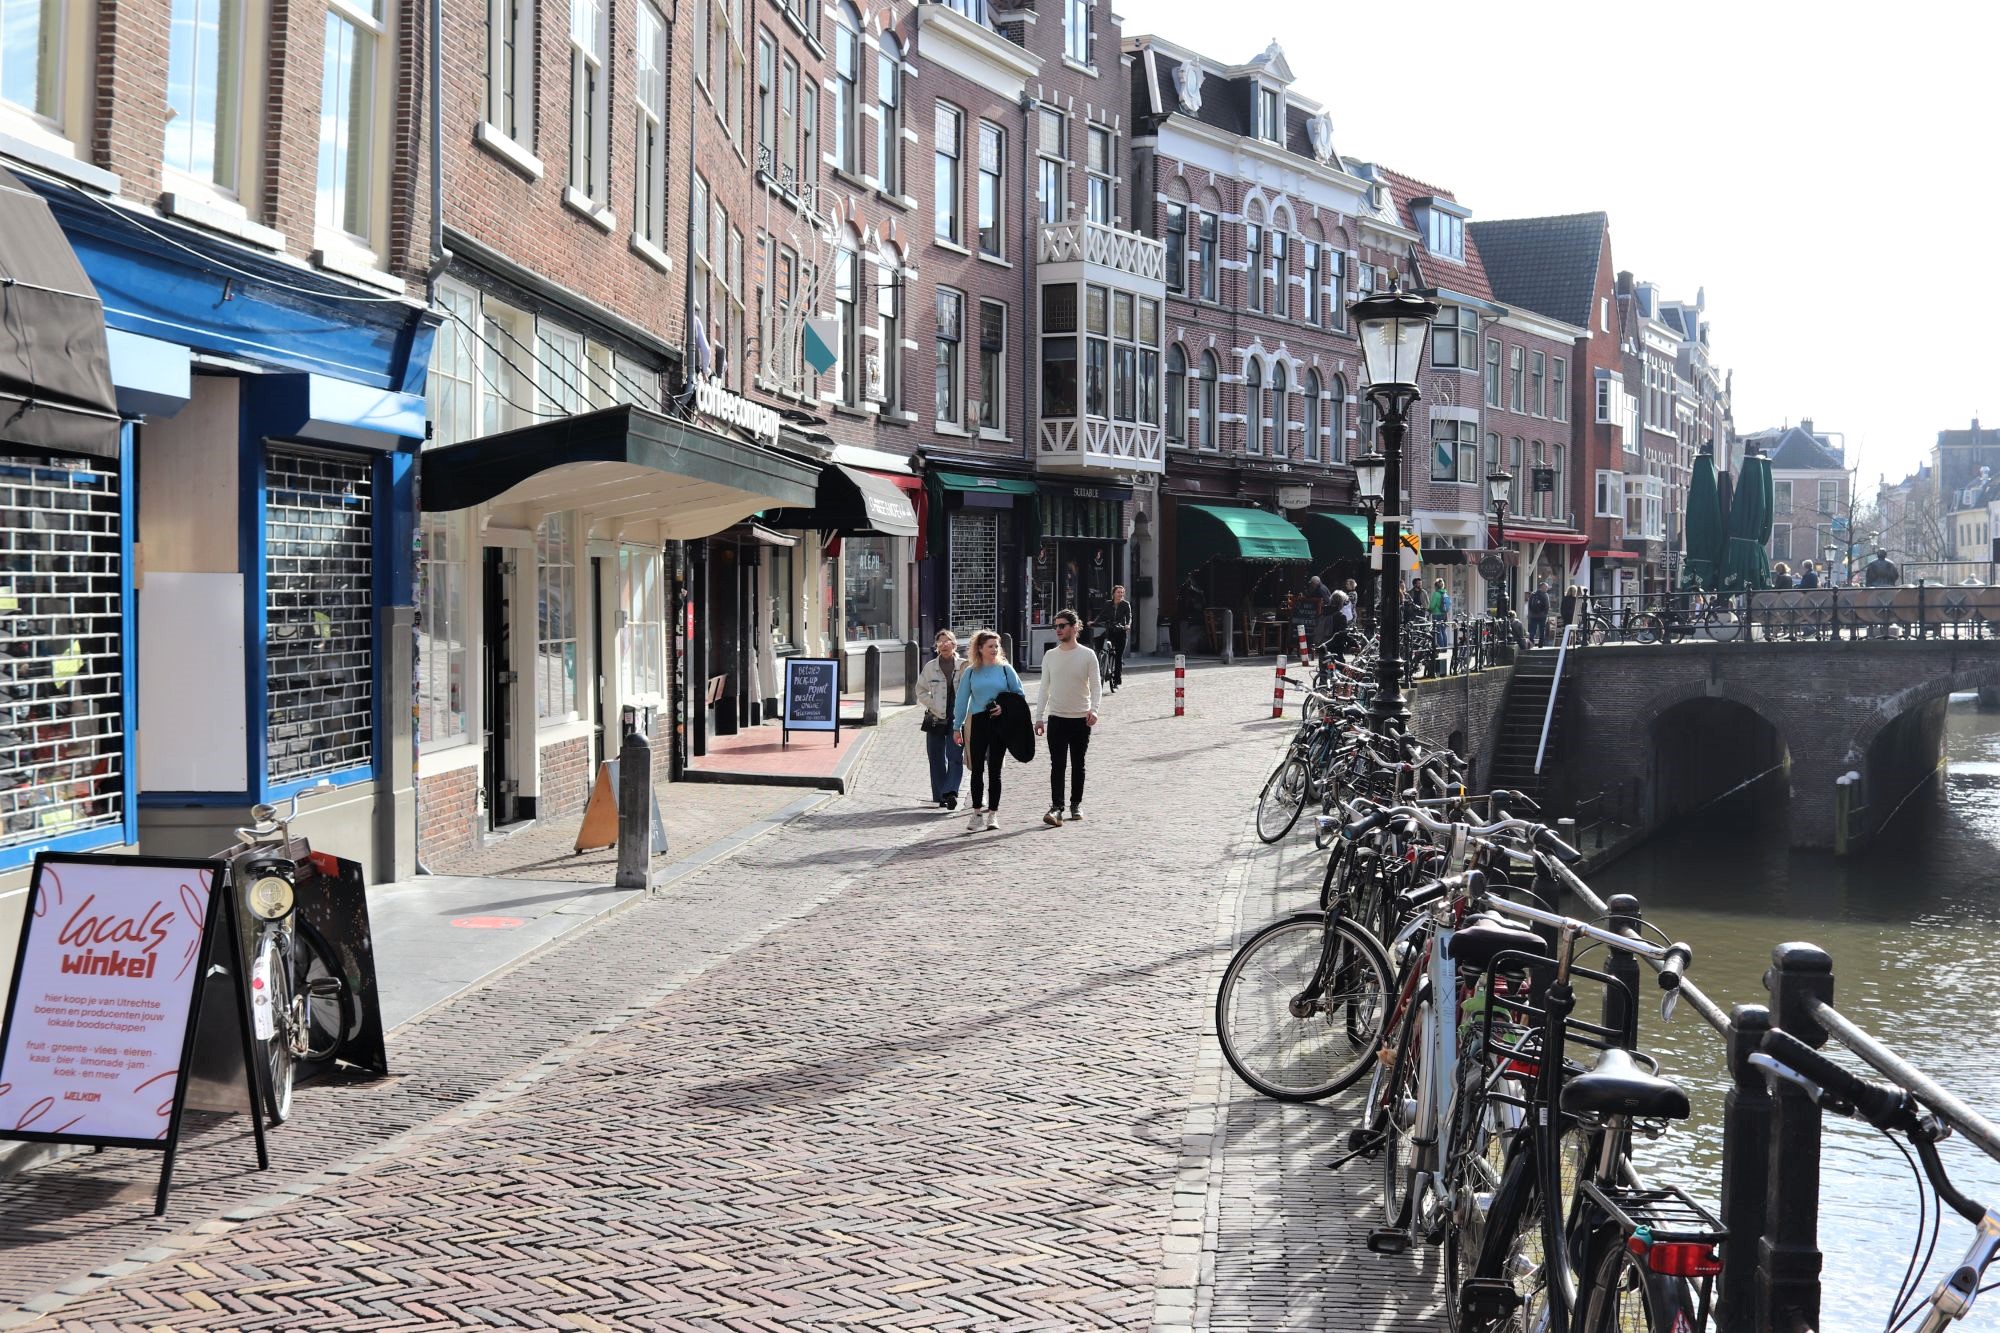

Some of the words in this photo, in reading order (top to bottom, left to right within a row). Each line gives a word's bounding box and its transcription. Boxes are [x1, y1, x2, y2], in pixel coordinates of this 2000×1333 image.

[696, 376, 780, 445] coffeecompany
[860, 554, 880, 570] ALEPH
[58, 894, 175, 955] locals
[61, 948, 158, 978] winkel
[45, 993, 61, 1002] hier
[64, 994, 87, 1006] koop
[87, 997, 96, 1006] je
[99, 998, 114, 1006] van
[117, 998, 161, 1009] Utrechtse
[34, 1005, 66, 1015] boeren
[80, 1008, 140, 1019] producenten
[141, 1012, 165, 1022] jouw
[48, 1018, 75, 1027] lokale
[76, 1020, 145, 1032] boodschappen
[26, 1041, 45, 1050] fruit
[51, 1043, 87, 1053] groente
[94, 1046, 117, 1055] vlees
[124, 1048, 152, 1056] eieren
[30, 1054, 50, 1063] kaas
[57, 1055, 74, 1064] bier
[80, 1056, 124, 1068] limonade
[54, 1067, 76, 1076] koek
[64, 1091, 102, 1102] WELKOM
